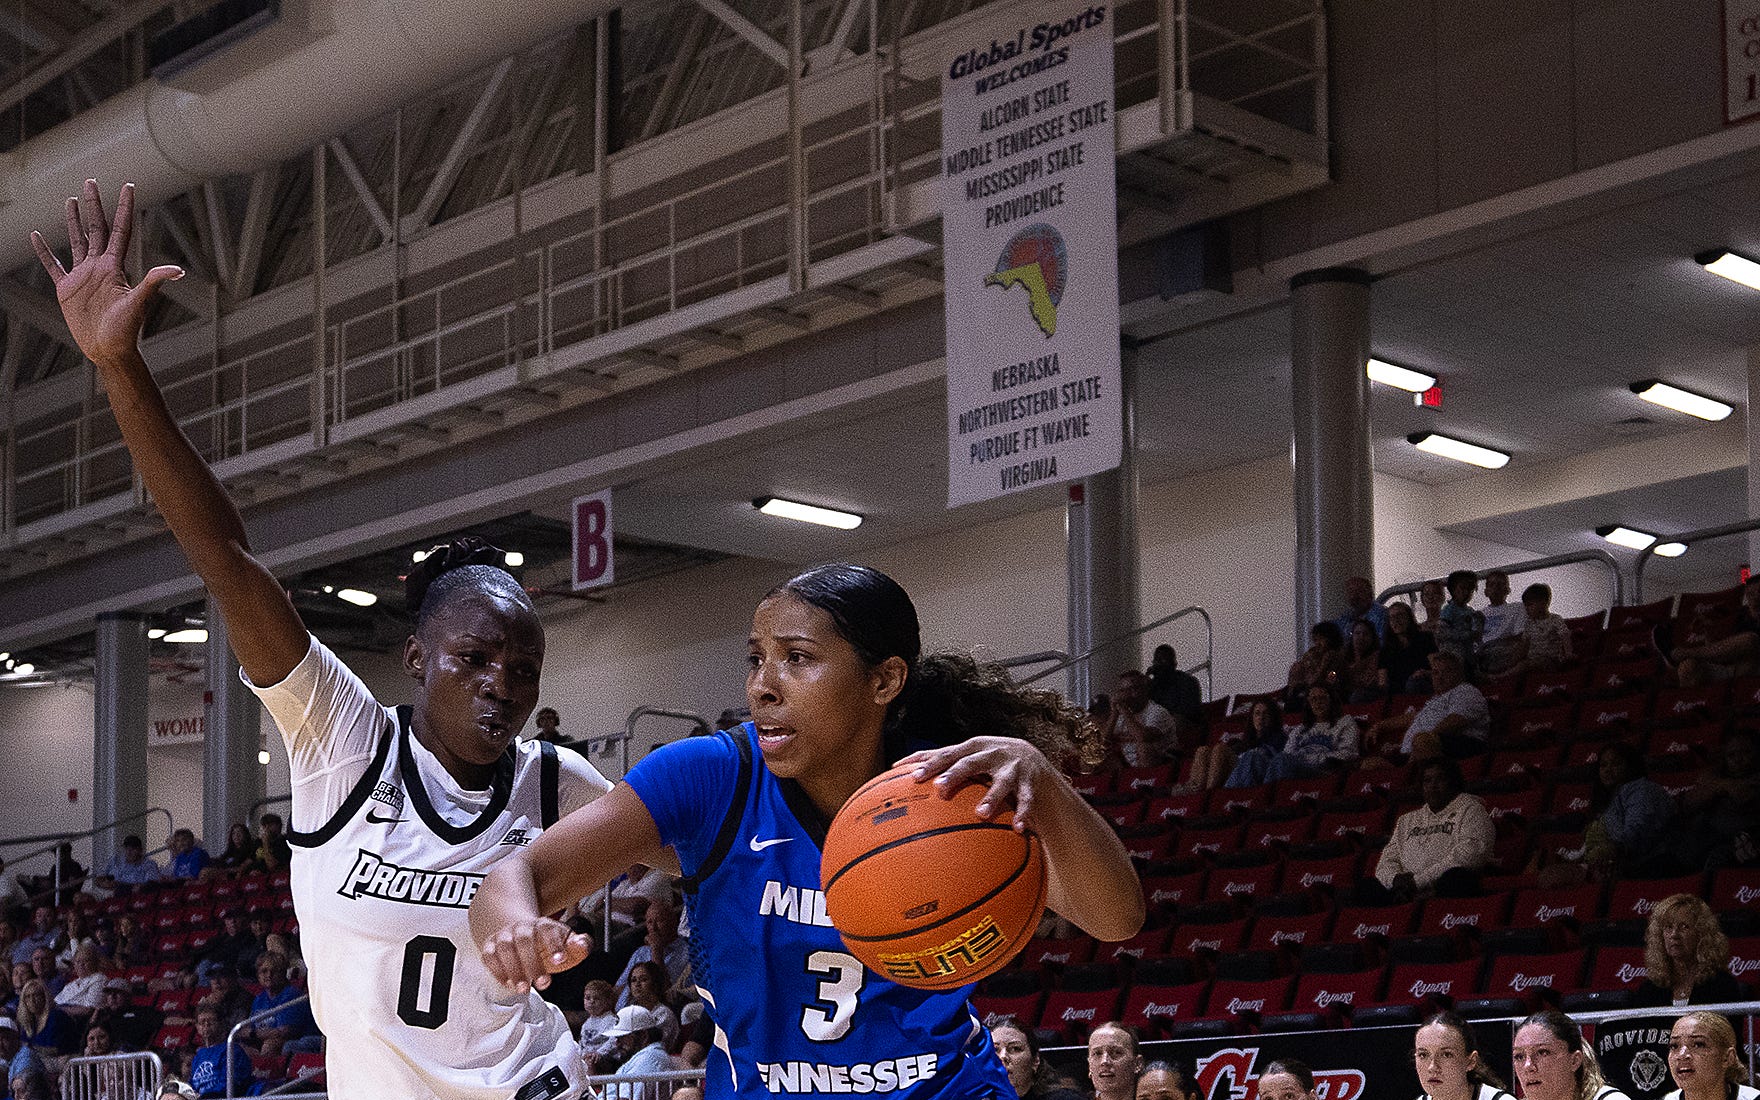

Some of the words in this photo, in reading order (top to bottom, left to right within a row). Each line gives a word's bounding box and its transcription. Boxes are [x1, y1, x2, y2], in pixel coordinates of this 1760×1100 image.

[950, 29, 1024, 79] Global
[1031, 6, 1105, 50] Sports
[975, 46, 1069, 95] WELCOMES
[980, 95, 1029, 132] ALCORN
[1034, 80, 1069, 113] STATE
[947, 142, 992, 177] MIDDLE
[996, 115, 1065, 160] TENNESSEE
[1069, 101, 1107, 133] STATE
[966, 156, 1042, 200] MISSISSIPPI
[1047, 142, 1084, 174] STATE
[986, 182, 1064, 228] PROVIDENCE
[992, 353, 1060, 392] NEBRASKA
[959, 388, 1058, 434] NORTHWESTERN
[1063, 376, 1101, 406] STATE
[970, 432, 1019, 463] PURDUE
[1024, 426, 1038, 449] FT
[1043, 414, 1090, 445] WAYNE
[1000, 457, 1057, 490] VIRGINIA
[577, 499, 607, 582] B
[397, 935, 457, 1030] 0
[801, 950, 864, 1041] 3
